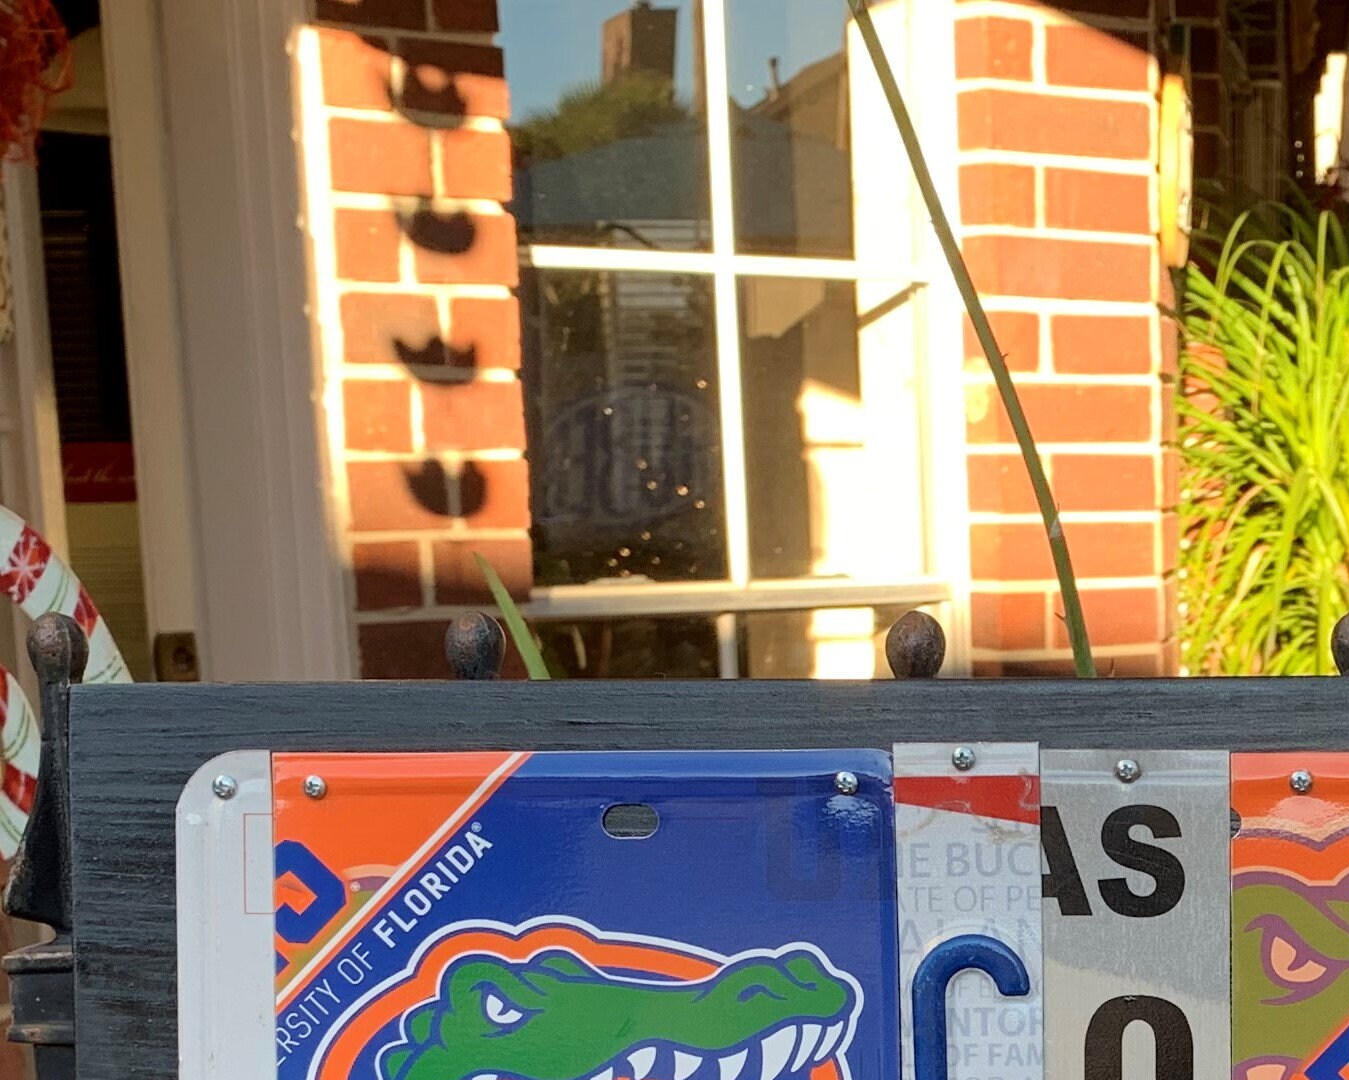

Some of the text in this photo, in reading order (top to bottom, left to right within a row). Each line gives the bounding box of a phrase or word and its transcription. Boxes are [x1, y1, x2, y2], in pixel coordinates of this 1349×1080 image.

[276, 978, 341, 1067] RSITY
[337, 941, 373, 985] OF
[372, 831, 493, 949] FLORIDA
[953, 885, 996, 913] OF
